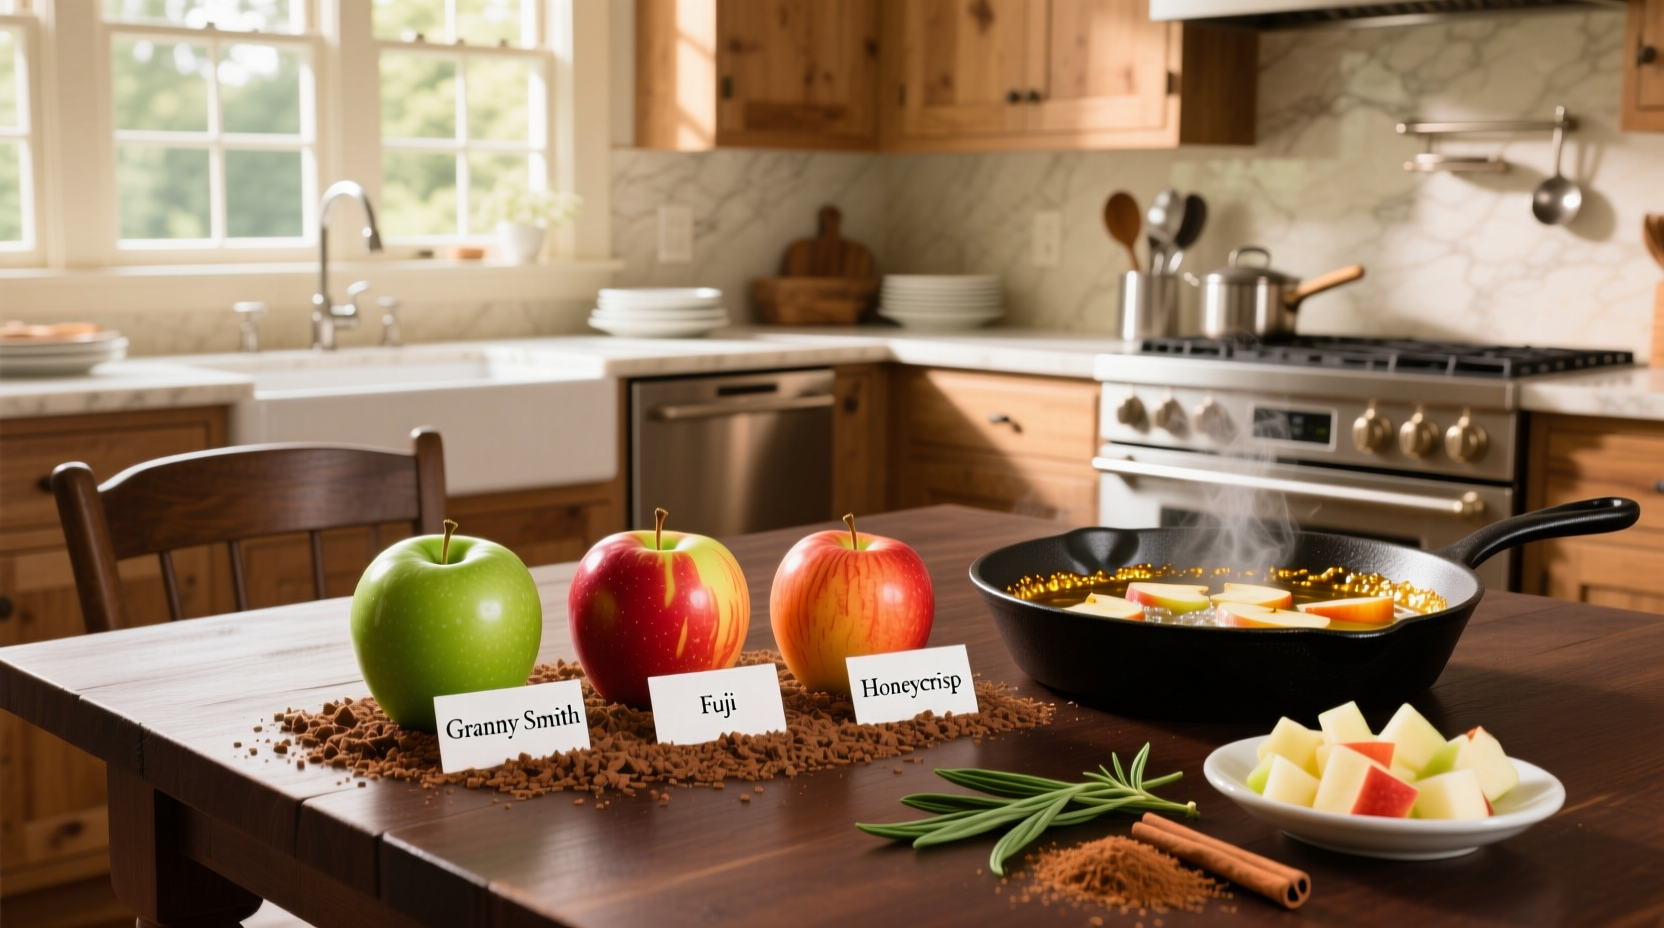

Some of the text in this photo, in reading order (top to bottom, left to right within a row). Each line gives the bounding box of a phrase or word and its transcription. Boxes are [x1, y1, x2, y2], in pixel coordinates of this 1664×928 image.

[861, 672, 962, 699] Honeycrisp
[700, 692, 737, 719] Fuji
[446, 704, 582, 741] Granny Smith
